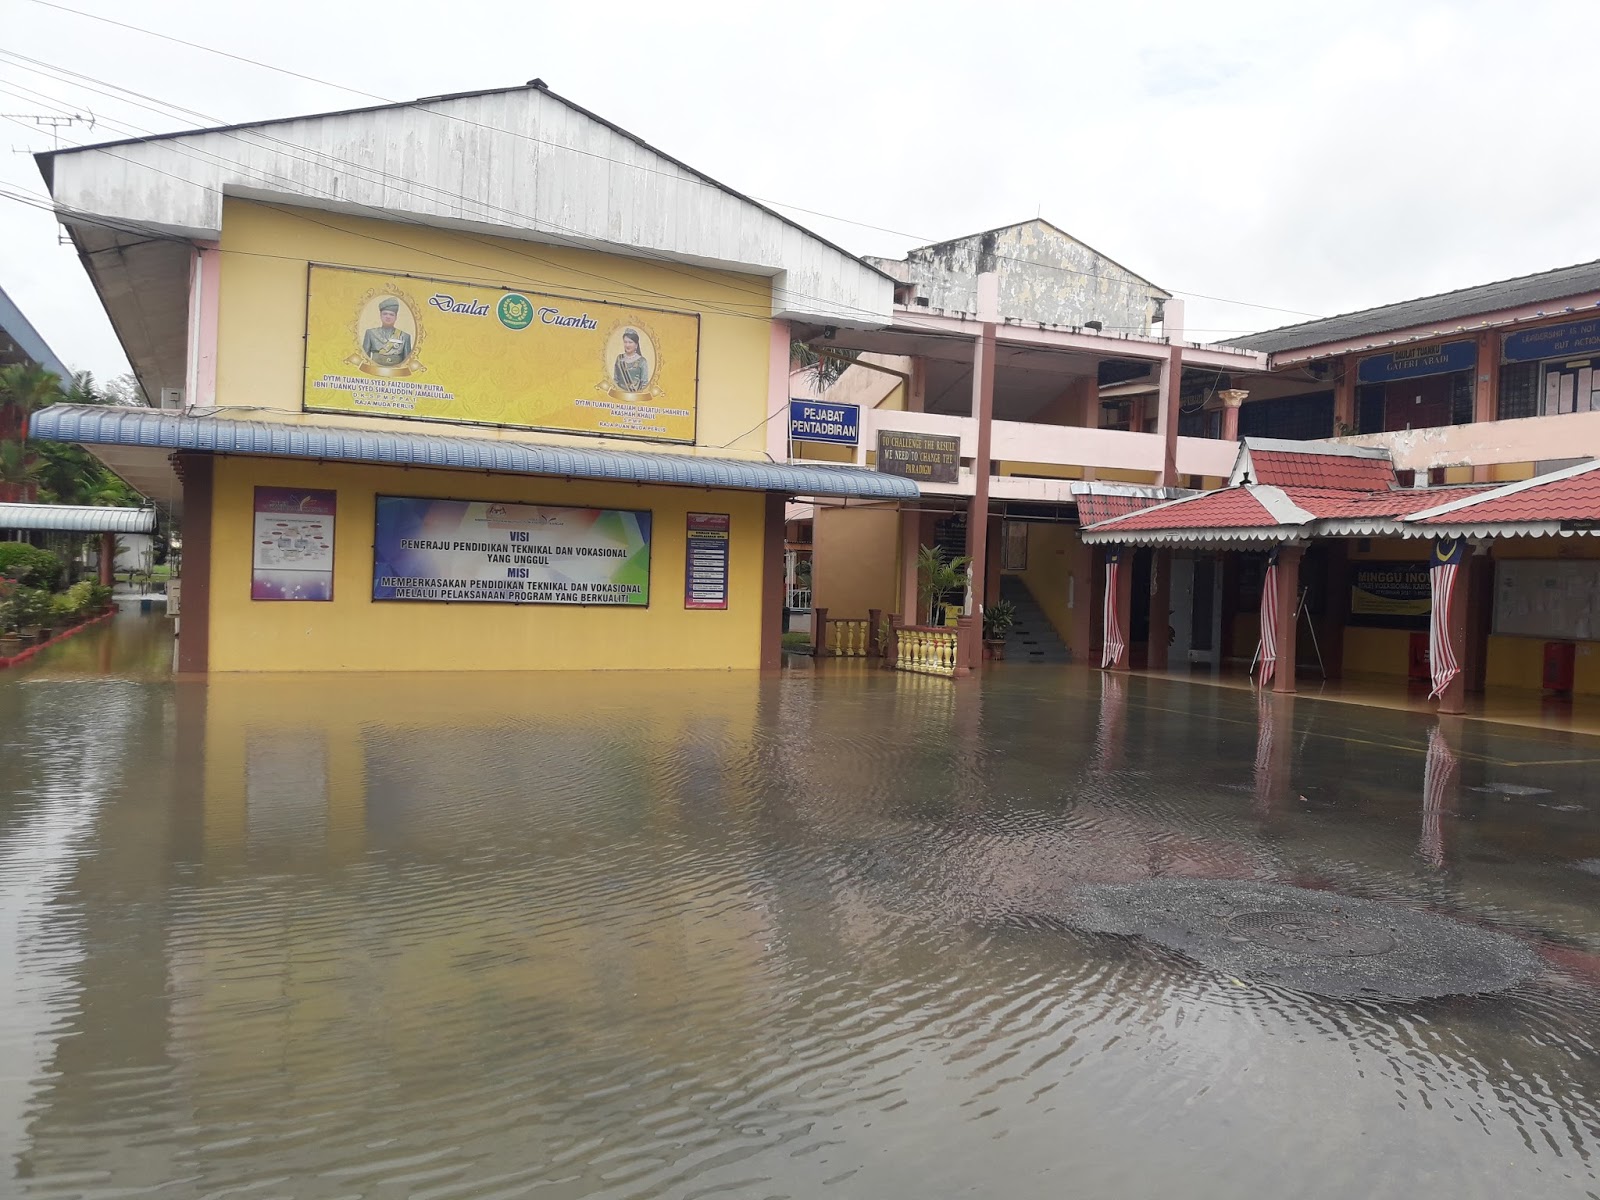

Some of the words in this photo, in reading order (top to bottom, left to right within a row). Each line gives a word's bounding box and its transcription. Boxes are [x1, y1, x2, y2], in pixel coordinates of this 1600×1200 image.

[429, 294, 490, 316] Daulat
[538, 307, 598, 329] Tuanku
[1580, 324, 1596, 333] NOT
[1395, 349, 1415, 360] DAULAT
[1417, 344, 1440, 356] TUANKU
[1554, 341, 1569, 350] BUT
[1386, 360, 1418, 370] GALERI
[1424, 354, 1449, 365] ABADI
[330, 382, 356, 391] TUANKU
[375, 386, 413, 396] SIRAJUDDIN
[343, 376, 369, 385] TUANKU
[371, 379, 385, 387] SYED
[387, 381, 422, 390] FAIZUDDIN
[424, 384, 444, 392] PUTRA
[592, 401, 615, 409] TUANKU
[803, 407, 845, 422] PEJABAT
[792, 420, 856, 437] PENTADBIRAN
[882, 436, 889, 446] TO
[891, 437, 922, 449] CHALLENGE
[924, 440, 934, 450] THE
[936, 441, 956, 452] RESULT
[884, 450, 893, 460] WE
[894, 450, 909, 461] NEED
[911, 451, 919, 461] TO
[920, 452, 941, 464] CHANGE
[943, 454, 953, 464] THE
[905, 464, 932, 475] PARADIGM
[510, 531, 529, 542] VISI
[401, 540, 451, 551] PENERAJU
[453, 542, 509, 553] PENDIDIKAN
[511, 544, 553, 555] TEKNIKAL
[556, 547, 573, 555] DAN
[576, 547, 627, 558] VOKASIONAL
[487, 554, 511, 563] YANG
[514, 555, 549, 565] UNGGUL
[507, 567, 529, 578] MISI
[1359, 572, 1401, 583] MINGGU
[381, 577, 467, 588] MEMPERKASAKAN
[470, 580, 524, 590] PENDIDIKAN
[527, 581, 568, 591] TEKNIKAL
[571, 583, 588, 592] DAN
[591, 583, 641, 593] VOKASIONAL
[396, 588, 437, 598] MELALUI
[441, 589, 506, 600] PELAKSANAAN
[509, 591, 552, 601] PROGRAM
[555, 592, 578, 601] YANG
[581, 594, 629, 603] BERKUALITI
